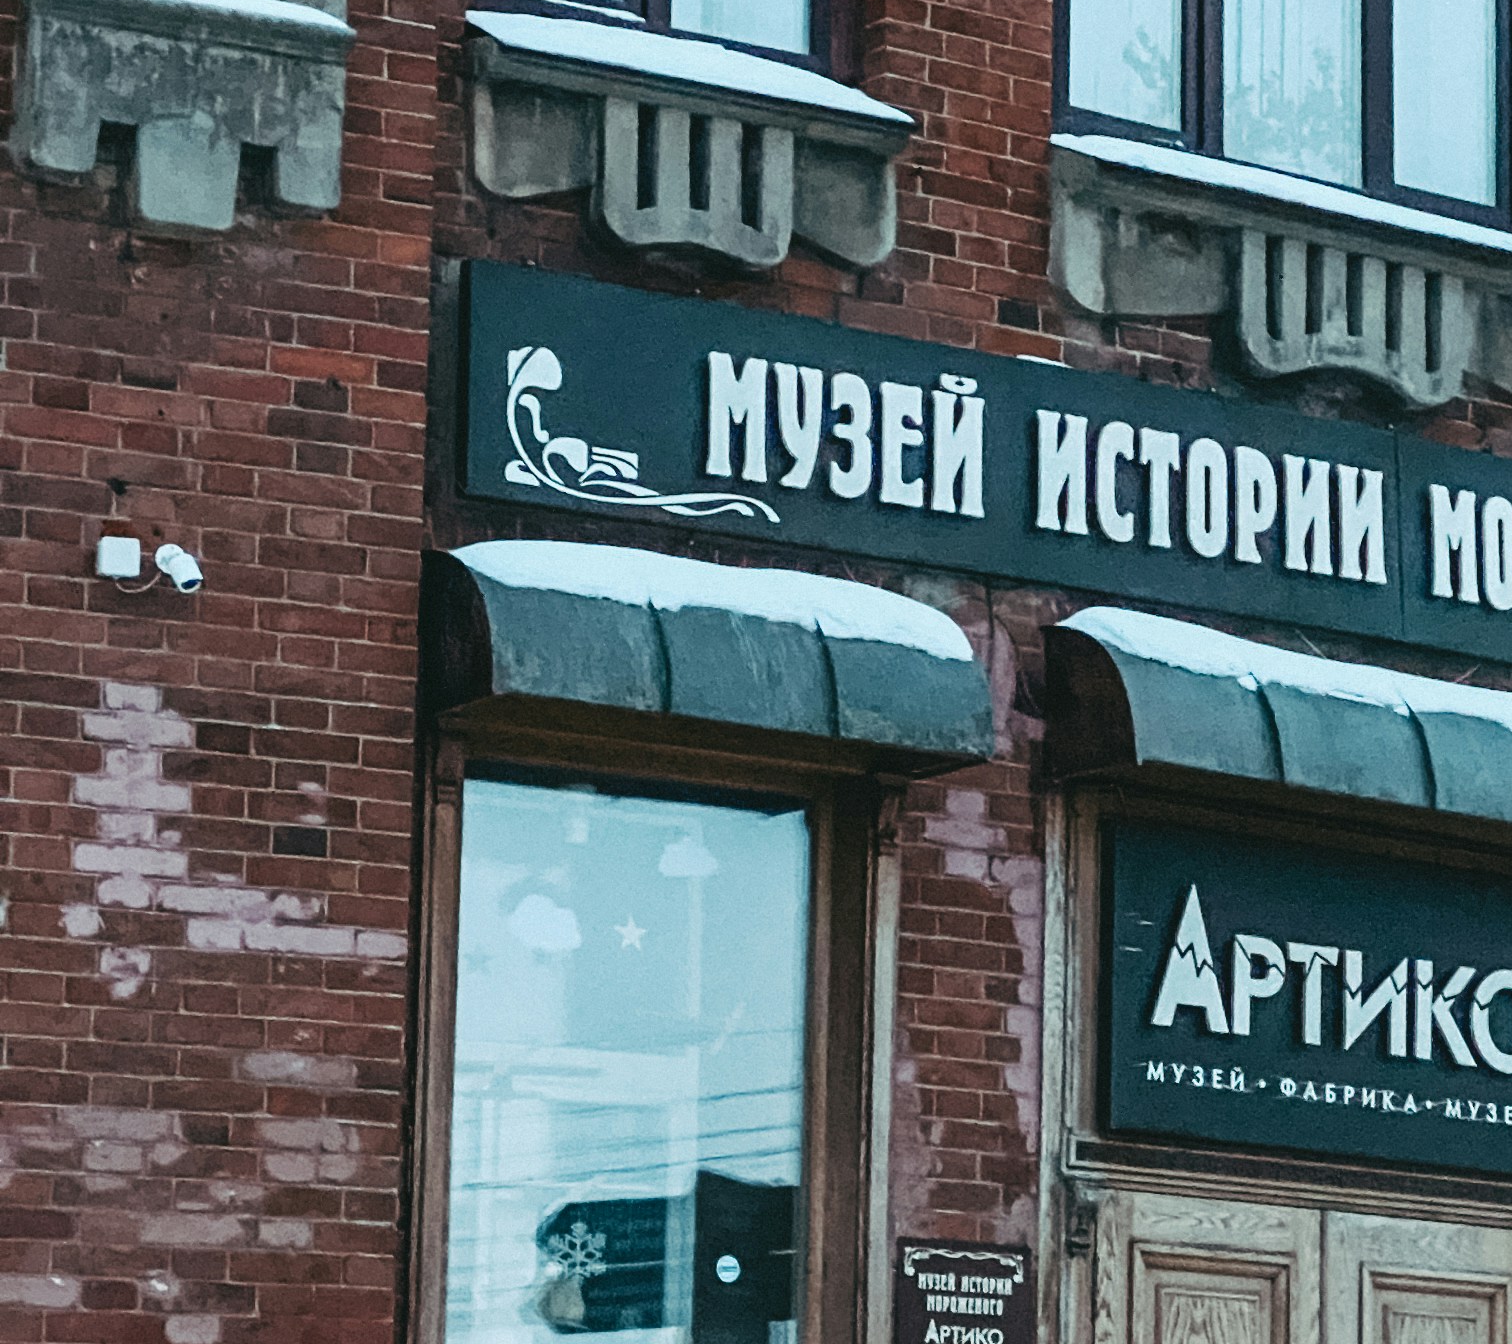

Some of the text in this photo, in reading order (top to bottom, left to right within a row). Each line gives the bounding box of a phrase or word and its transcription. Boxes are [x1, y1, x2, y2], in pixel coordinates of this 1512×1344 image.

[706, 351, 985, 518] МУЗЕЙ
[1035, 409, 1387, 585] ИСТОРИИ
[1146, 1060, 1245, 1092] МУЗЕЙ
[1280, 1077, 1418, 1114] ФАБРИКА
[918, 1272, 1012, 1295] МУЗЕЙ ИСТОРИИ
